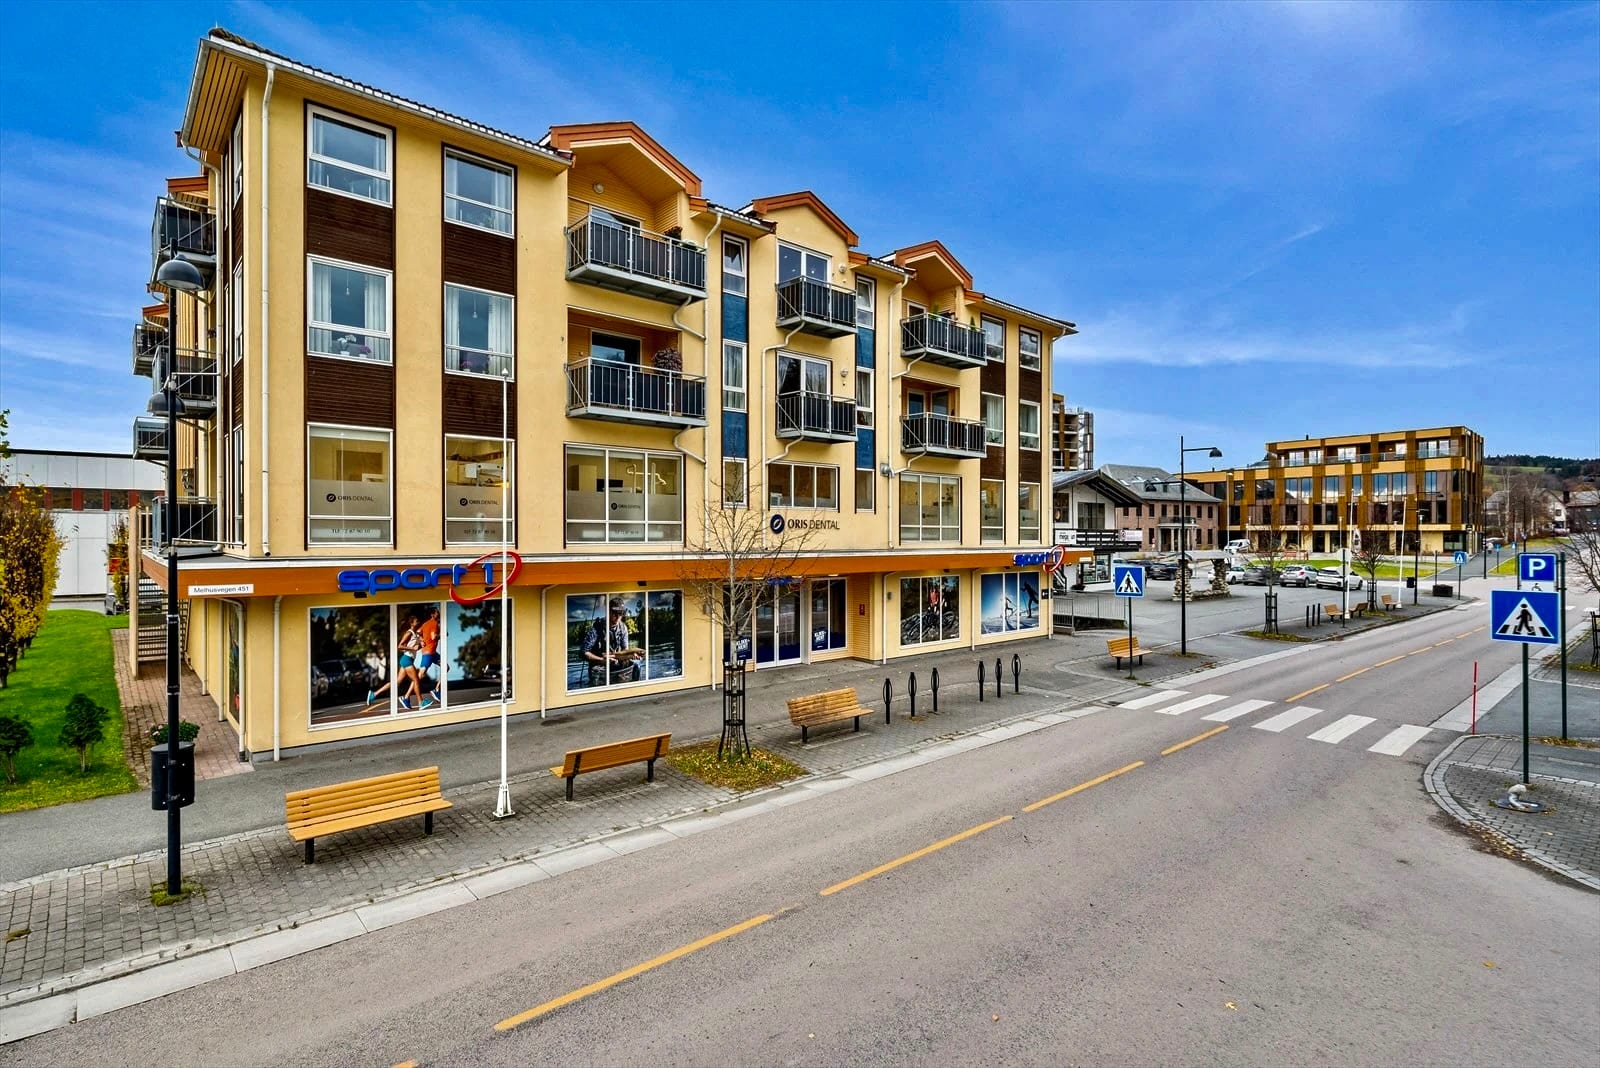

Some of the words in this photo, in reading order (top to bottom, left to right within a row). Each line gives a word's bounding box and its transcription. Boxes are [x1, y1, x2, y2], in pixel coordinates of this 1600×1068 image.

[787, 518, 808, 529] ORIS
[809, 519, 840, 530] DENTAL
[1013, 550, 1049, 567] sport
[1528, 558, 1546, 578] P
[337, 563, 467, 596] sport
[482, 562, 493, 585] 1
